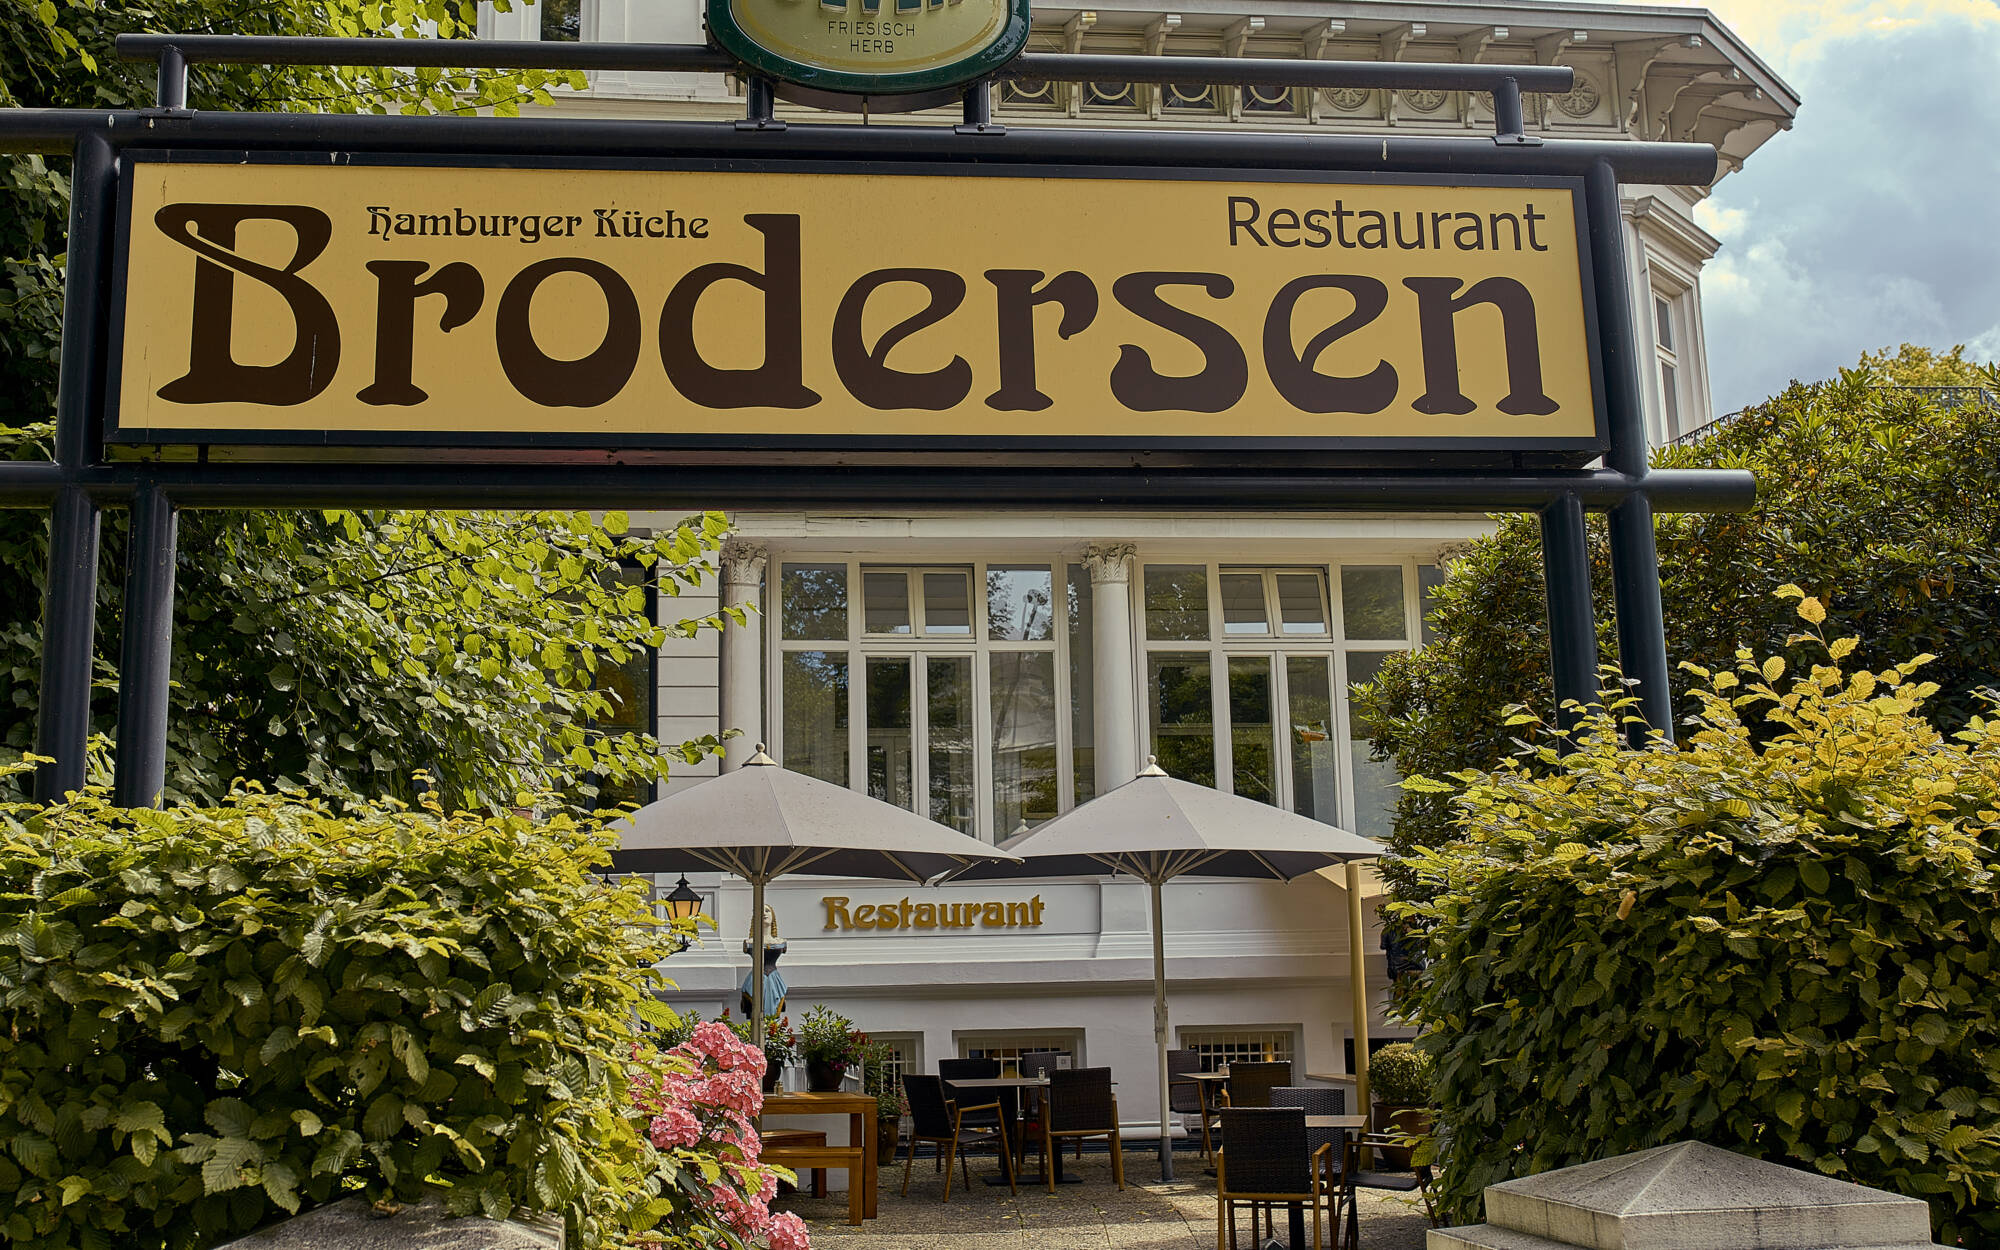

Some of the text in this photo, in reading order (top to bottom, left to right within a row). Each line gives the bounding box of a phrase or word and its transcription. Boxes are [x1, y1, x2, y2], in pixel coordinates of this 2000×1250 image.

[827, 21, 915, 36] FRIESISCH
[850, 39, 894, 53] HERB
[593, 209, 709, 240] Küche
[1228, 195, 1549, 252] Restaurant
[154, 203, 1561, 416] Brodersen
[821, 894, 1045, 931] Restaurant
